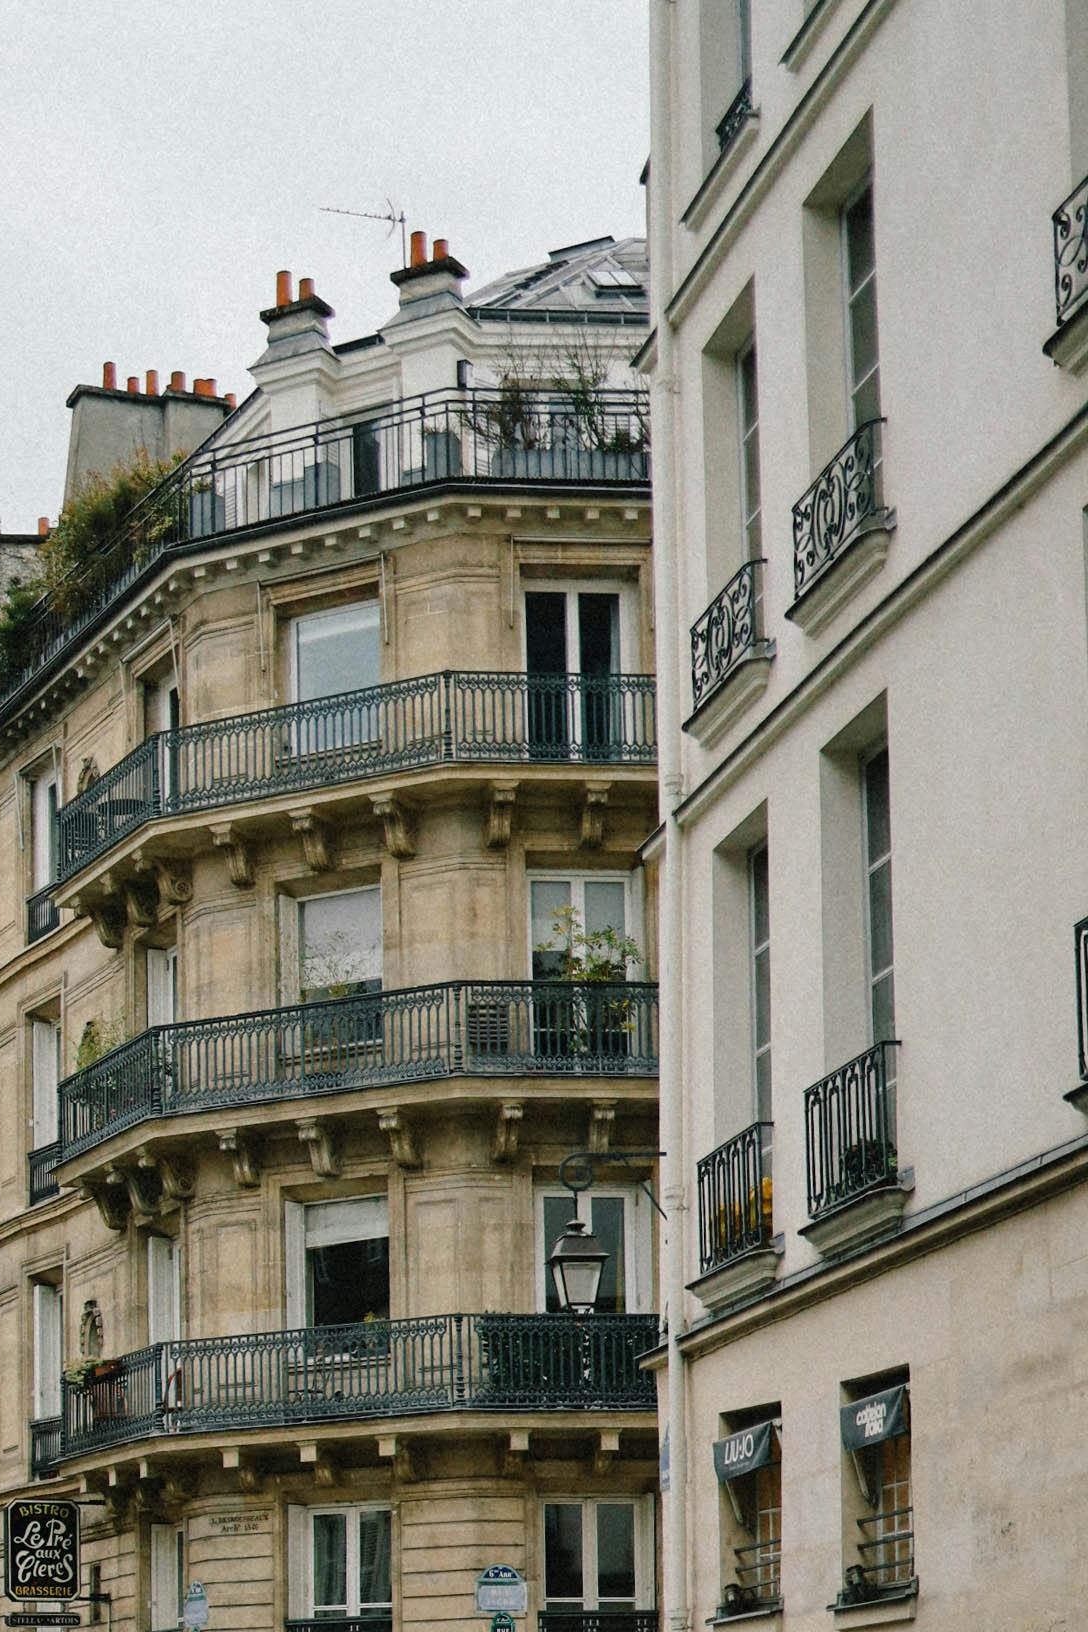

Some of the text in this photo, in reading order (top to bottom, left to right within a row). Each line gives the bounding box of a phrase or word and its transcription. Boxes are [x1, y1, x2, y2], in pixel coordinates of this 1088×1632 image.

[18, 1503, 70, 1518] BISTRO
[13, 1518, 73, 1550] Le Pré
[35, 1548, 61, 1560] aux
[15, 1586, 73, 1596] BRASSERIE
